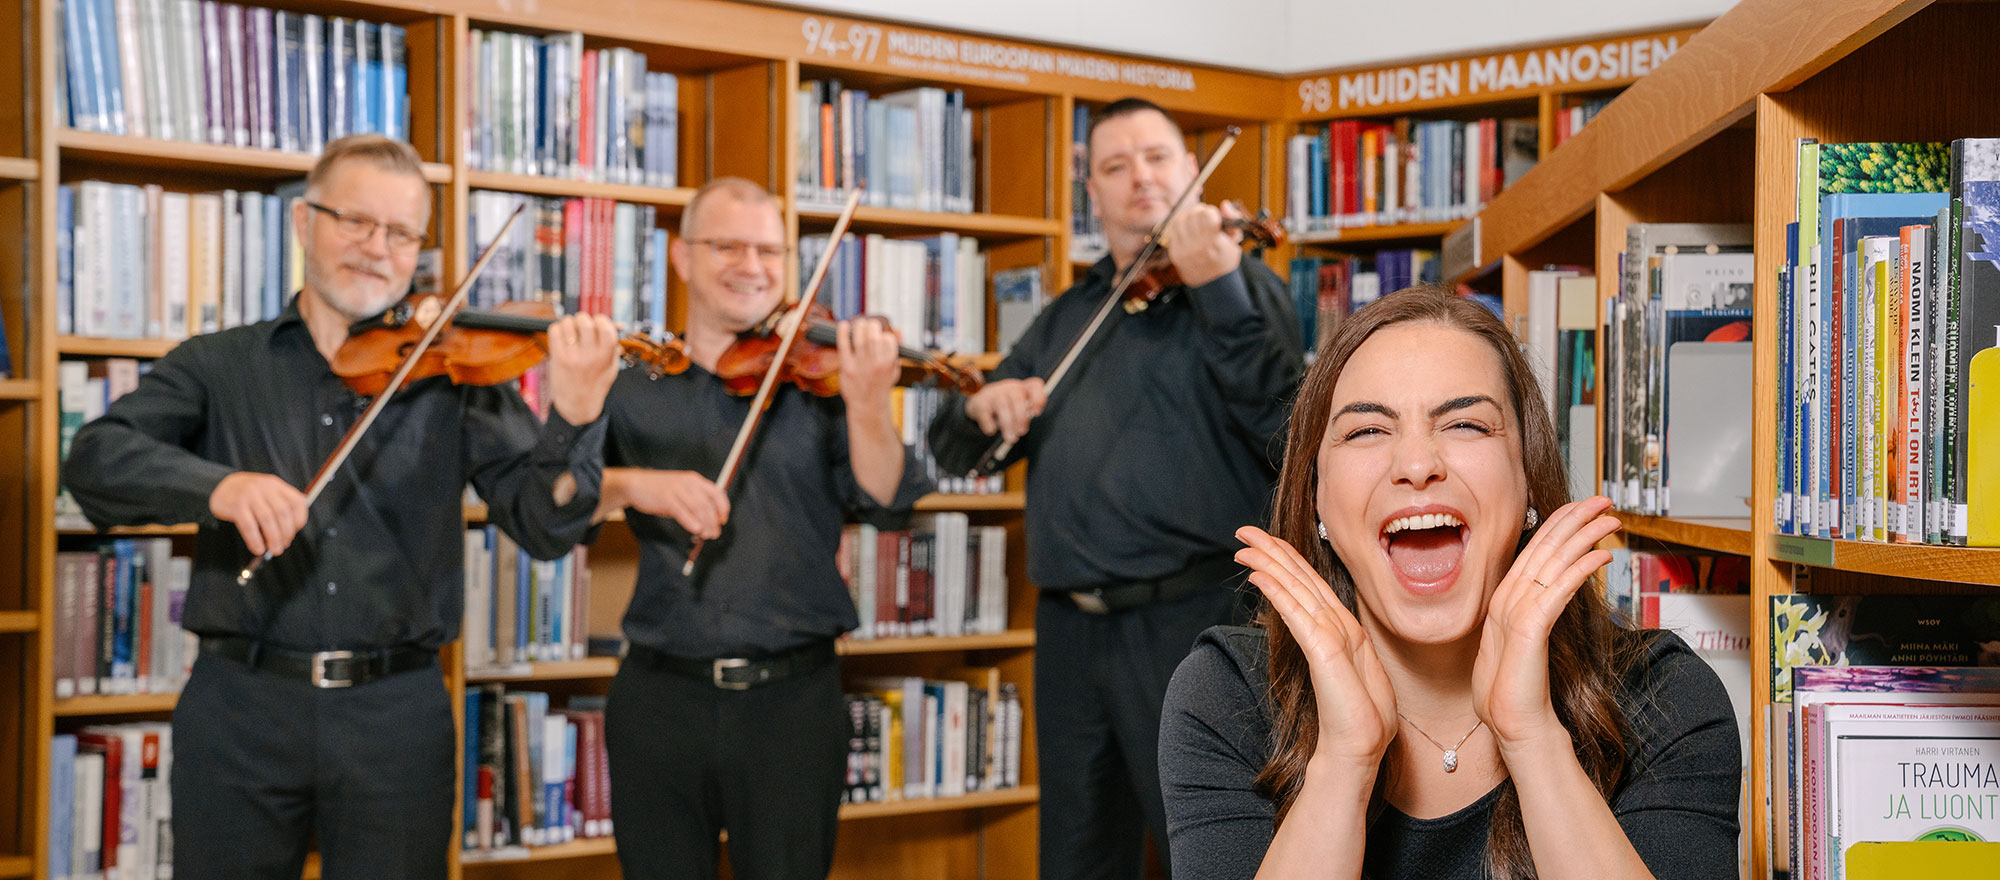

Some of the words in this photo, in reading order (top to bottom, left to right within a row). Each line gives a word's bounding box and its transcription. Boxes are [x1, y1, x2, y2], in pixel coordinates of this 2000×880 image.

[801, 17, 882, 64] 94-97
[1299, 77, 1333, 113] 98
[1338, 61, 1460, 109] MUIDEN
[1469, 36, 1678, 93] MAANOSIEN
[1911, 261, 1921, 322] NAOMI
[1910, 328, 1920, 382] KLEIN
[1909, 439, 1919, 464] ON
[1909, 470, 1919, 500] IRT
[1933, 641, 1959, 650] MÄKI
[1915, 747, 1938, 756] HARRI
[1940, 747, 1980, 756] VIRTANEN
[1897, 762, 1999, 788] TRAUMA
[1883, 793, 1912, 820] JA
[1920, 793, 1999, 820] LUONT
